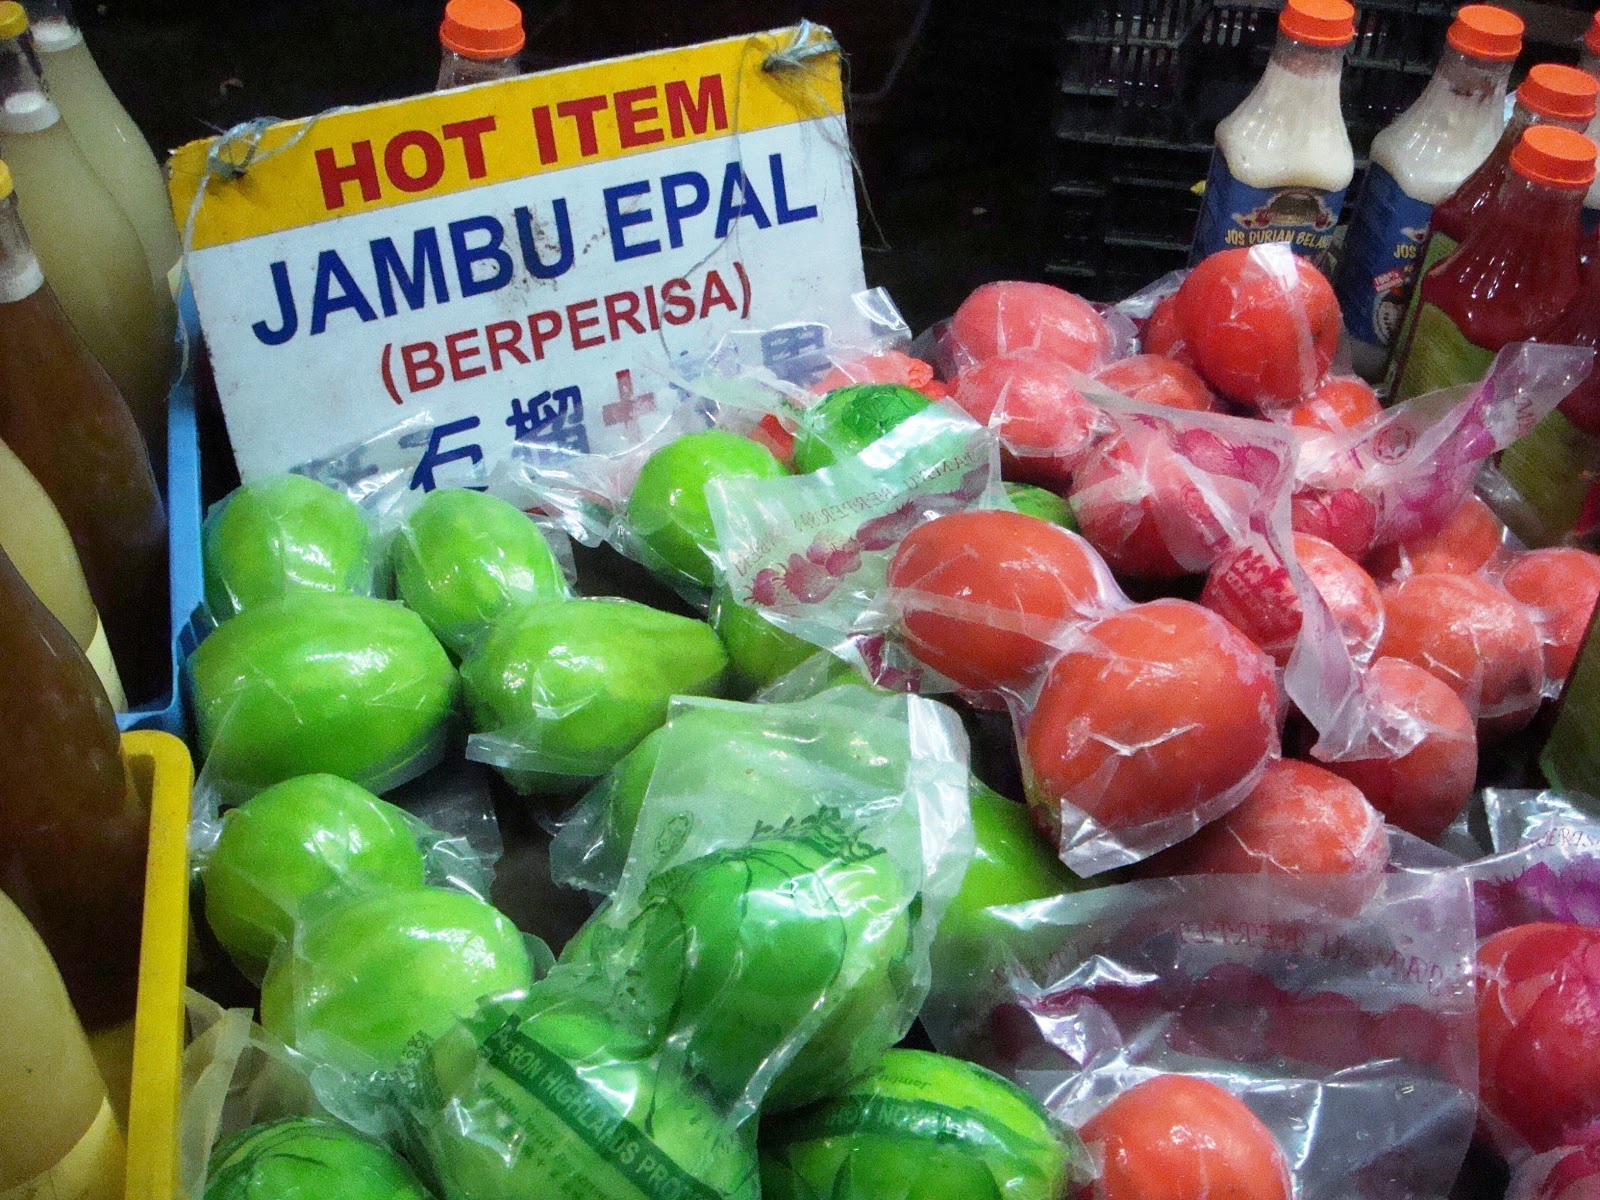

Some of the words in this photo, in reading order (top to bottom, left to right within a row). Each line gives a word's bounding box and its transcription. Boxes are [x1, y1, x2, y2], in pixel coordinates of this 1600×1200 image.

[314, 116, 498, 211] HOT
[531, 73, 729, 166] ITEM
[252, 197, 577, 346] JAMBU
[602, 152, 819, 263] EPAL
[1224, 229, 1245, 246] JOS
[1249, 229, 1295, 246] DURIAN
[1393, 243, 1417, 259] JOS
[381, 261, 753, 405] (BERPERISA)
[539, 1073, 642, 1166] HIGHLANDS
